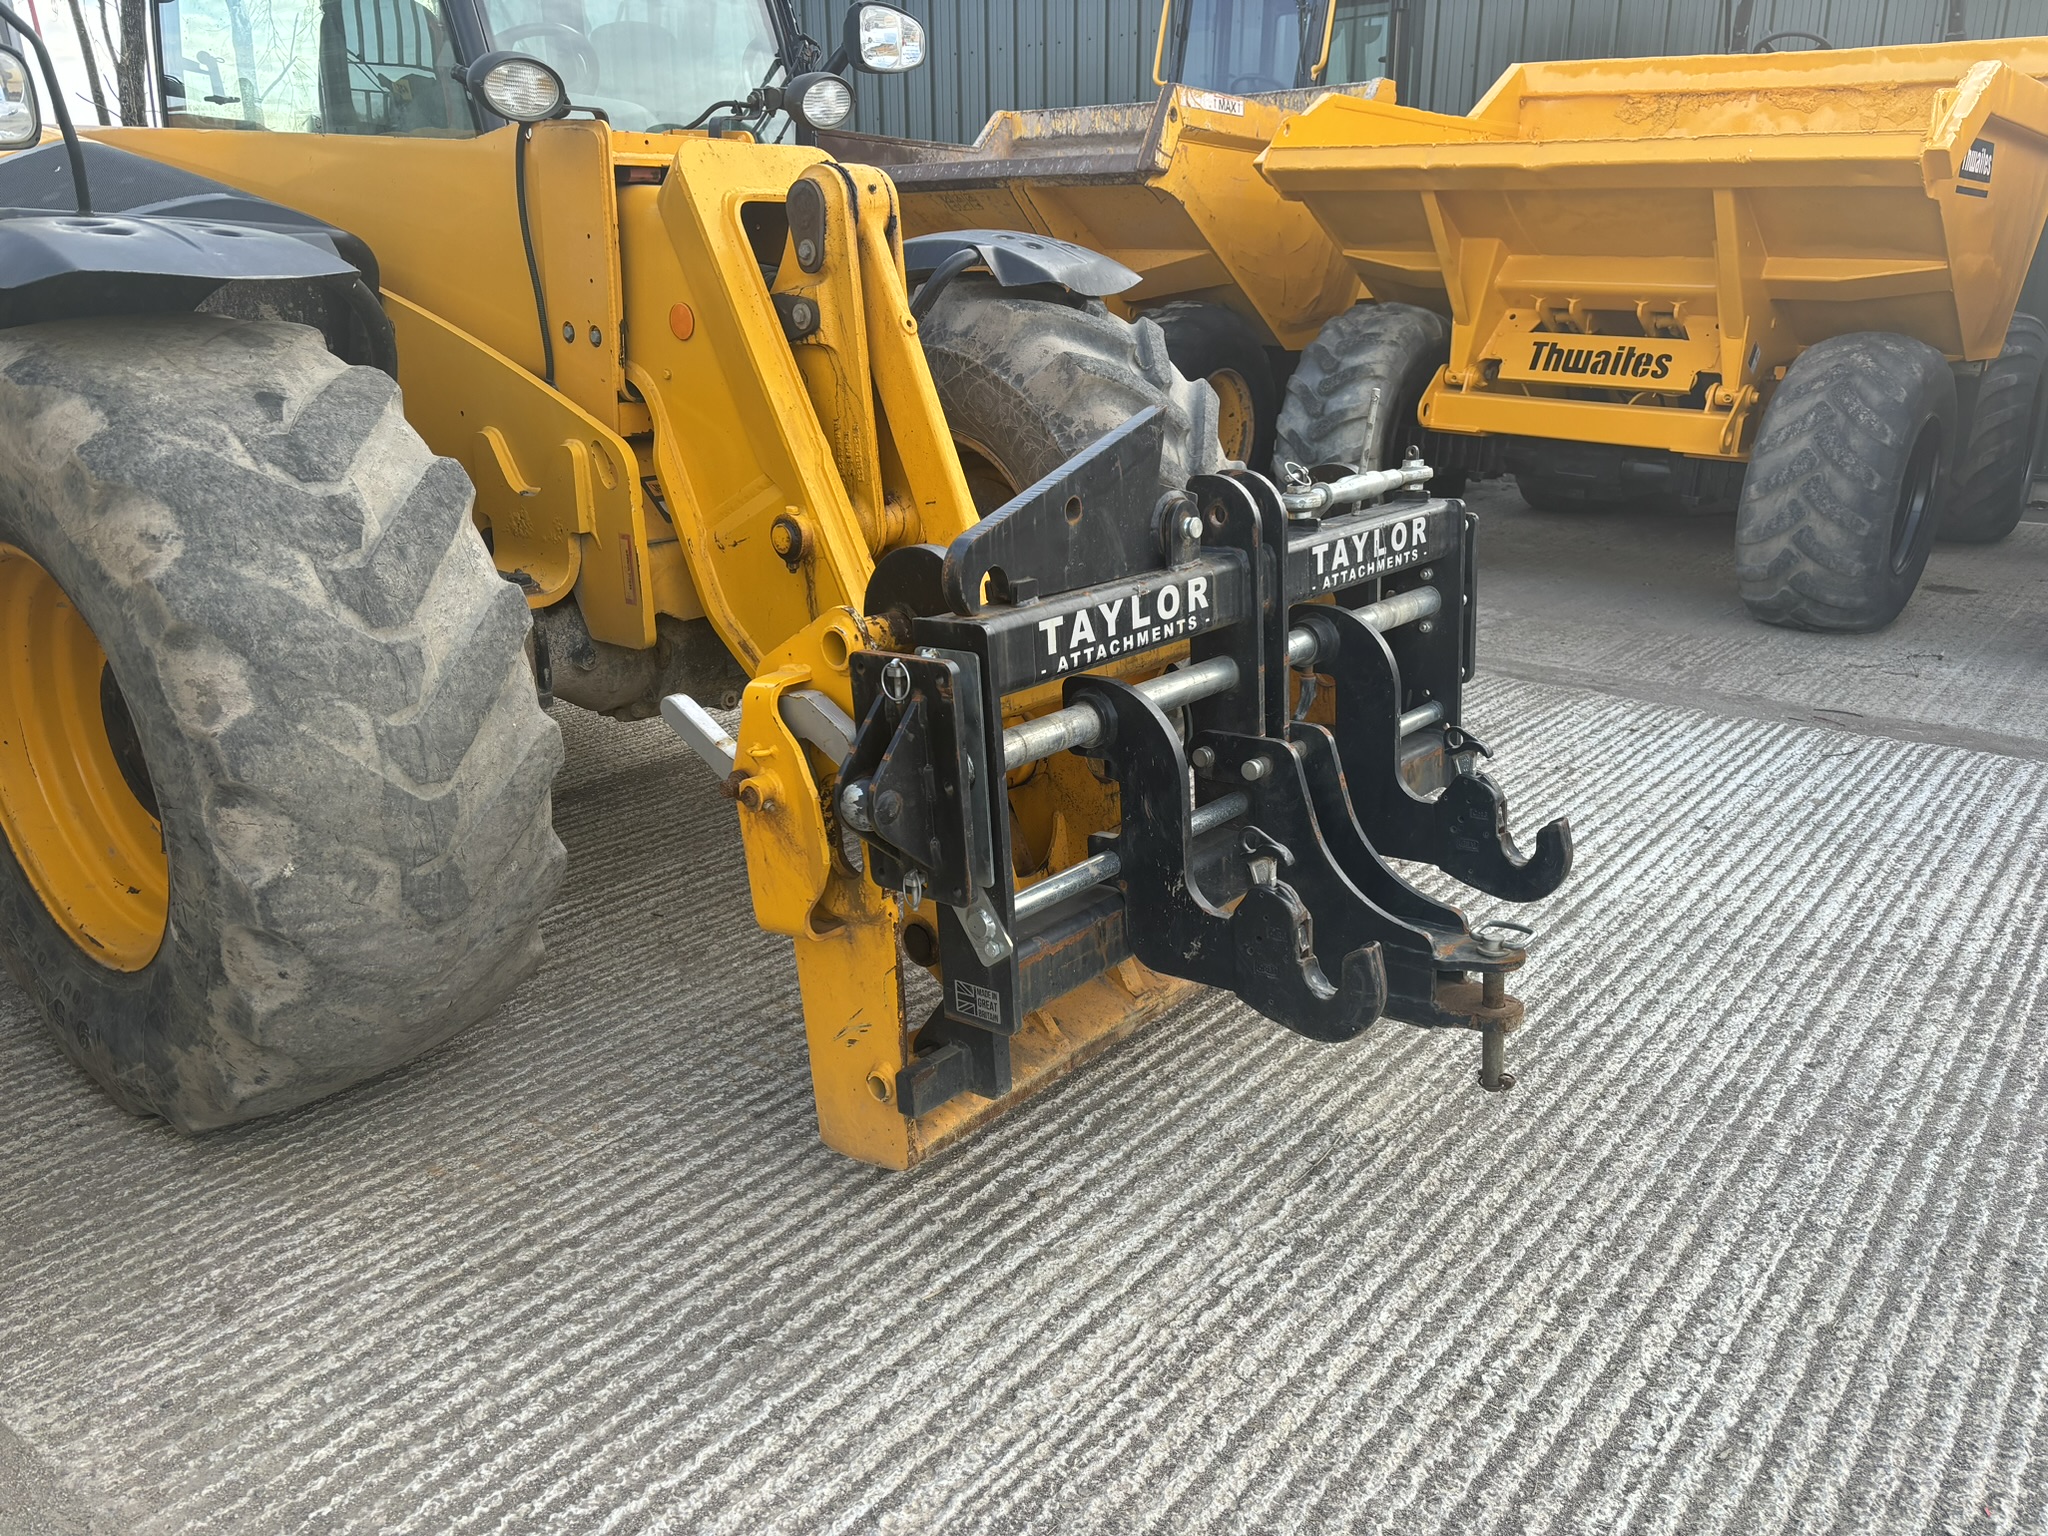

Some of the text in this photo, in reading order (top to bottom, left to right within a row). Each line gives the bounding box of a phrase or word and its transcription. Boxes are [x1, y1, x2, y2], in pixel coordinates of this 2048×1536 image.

[1529, 341, 1672, 379] Thwaites
[1312, 516, 1427, 575] TAYLOR
[1322, 549, 1418, 590] ATTACHMENTS
[1038, 576, 1209, 656] TAYLOR
[1057, 615, 1197, 673] ATTACHMENTS
[976, 987, 991, 999] MADE
[977, 998, 998, 1012] GREAT
